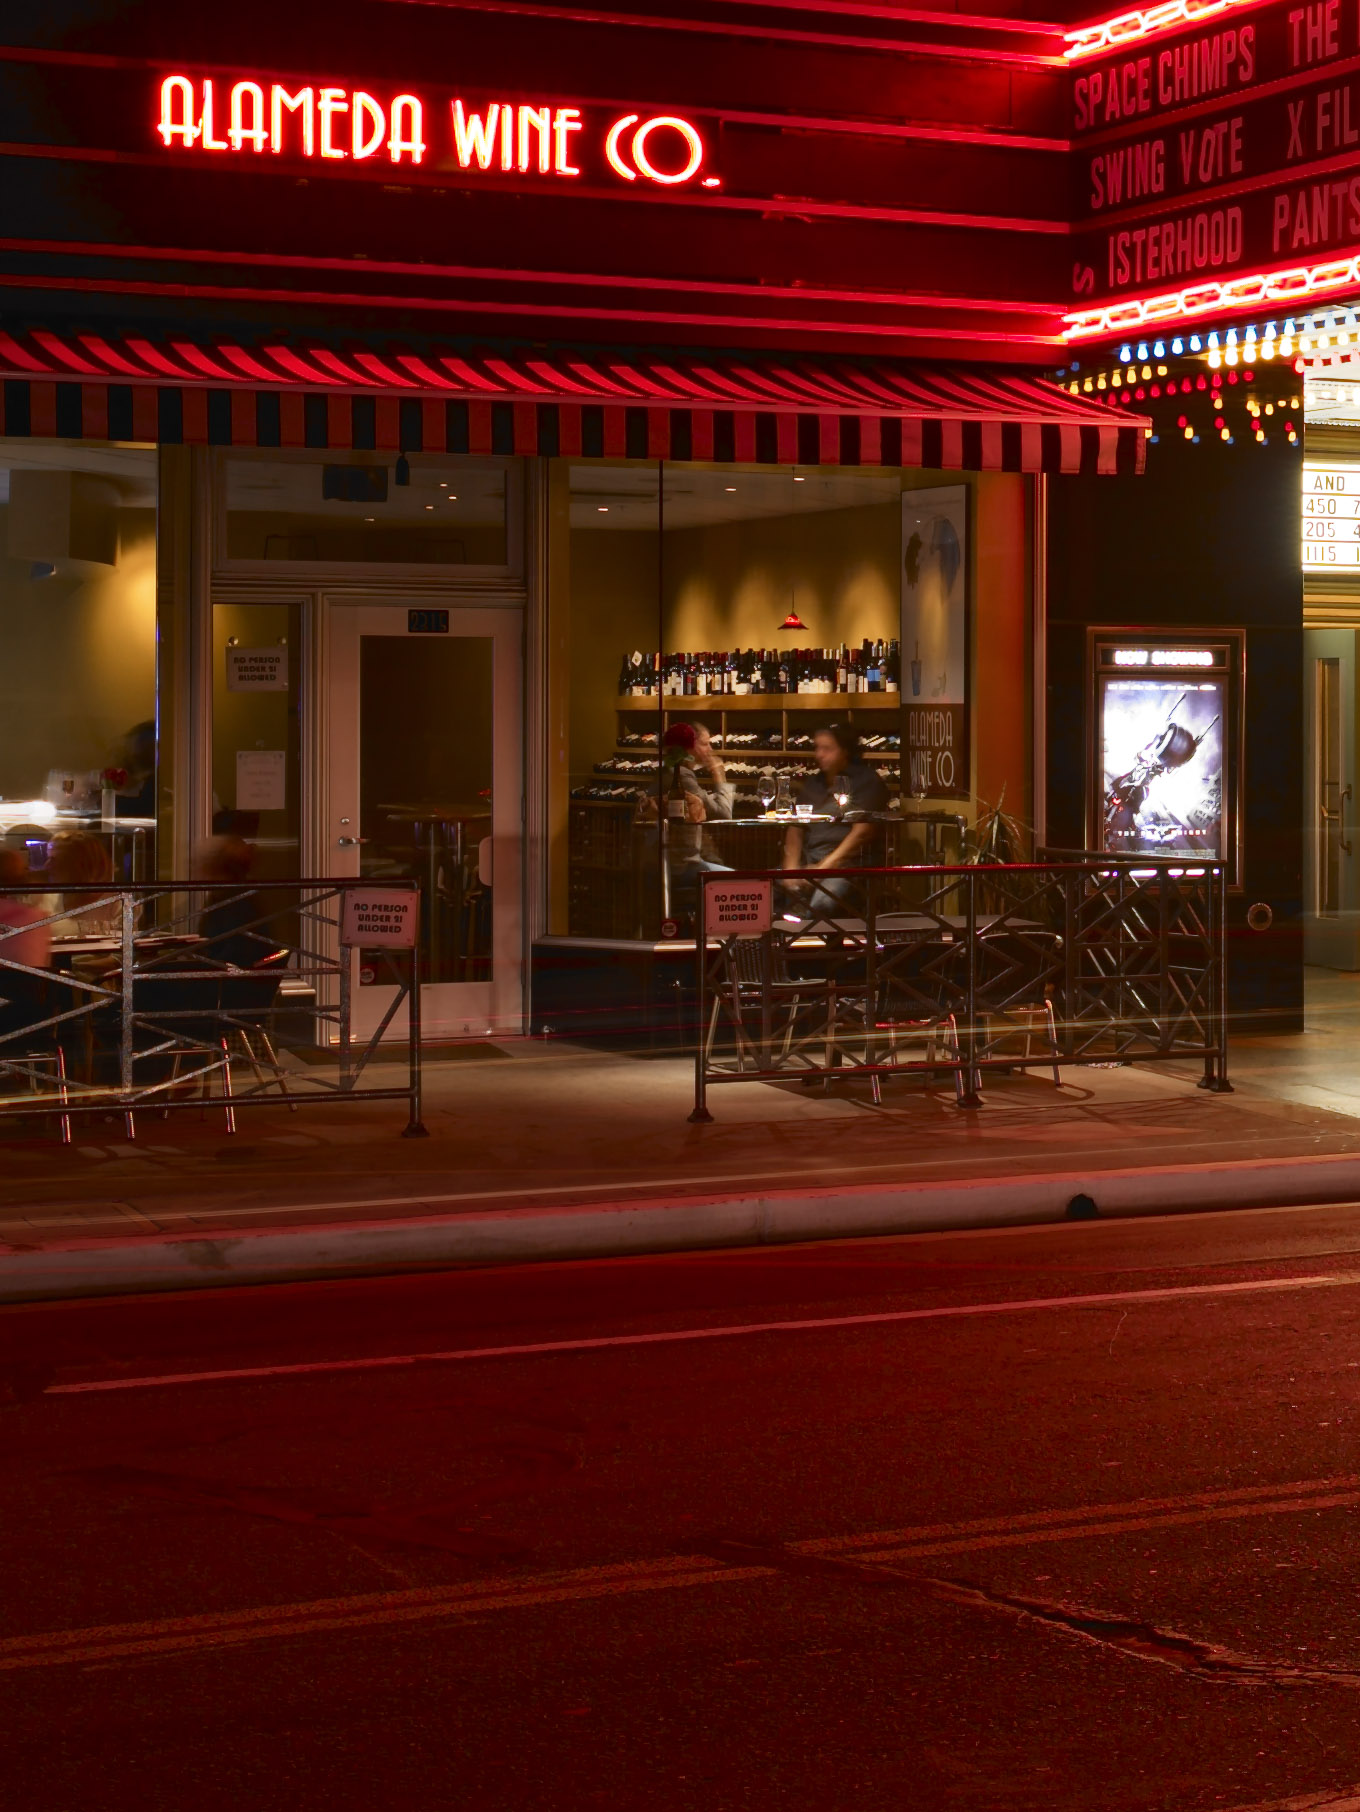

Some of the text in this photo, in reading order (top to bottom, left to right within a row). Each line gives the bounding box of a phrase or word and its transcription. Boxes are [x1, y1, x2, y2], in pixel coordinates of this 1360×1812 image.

[1075, 58, 1150, 130] SPACE
[1158, 25, 1254, 105] CHIMPS
[157, 75, 426, 164] ALAMEDA
[451, 99, 582, 175] WINE
[1091, 140, 1164, 209] SWING
[1179, 117, 1243, 184] VOTE
[1288, 101, 1303, 159] X
[1314, 475, 1345, 491] AND
[1306, 499, 1336, 514] 450
[1306, 522, 1335, 537] 205
[1306, 546, 1336, 562] 1115
[909, 711, 952, 746] ALAMEDA
[730, 894, 762, 902] PERSON
[354, 903, 408, 912] NO PERSON
[719, 904, 747, 912] UNDER
[358, 914, 390, 922] UNDER
[358, 924, 401, 933] ALLOWED
